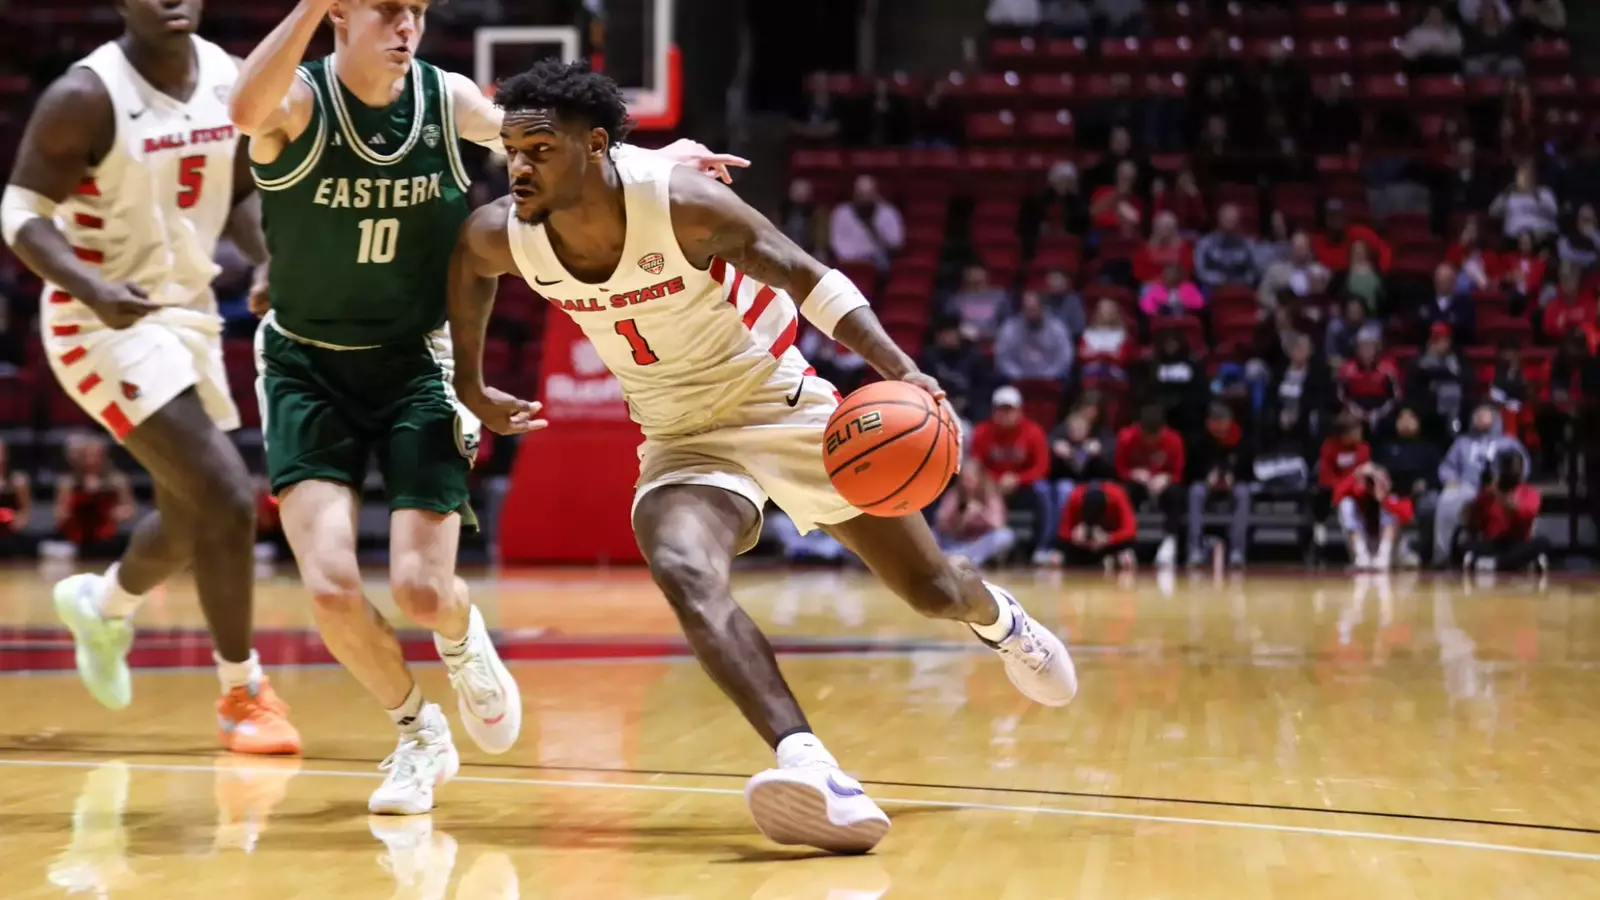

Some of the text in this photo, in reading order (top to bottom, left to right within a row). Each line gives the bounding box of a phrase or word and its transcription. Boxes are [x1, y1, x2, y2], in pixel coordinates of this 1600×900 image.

[177, 154, 206, 210] 5
[356, 217, 400, 264] 10
[609, 275, 686, 309] STATE
[614, 318, 660, 366] 1
[826, 410, 882, 456] ELITE
